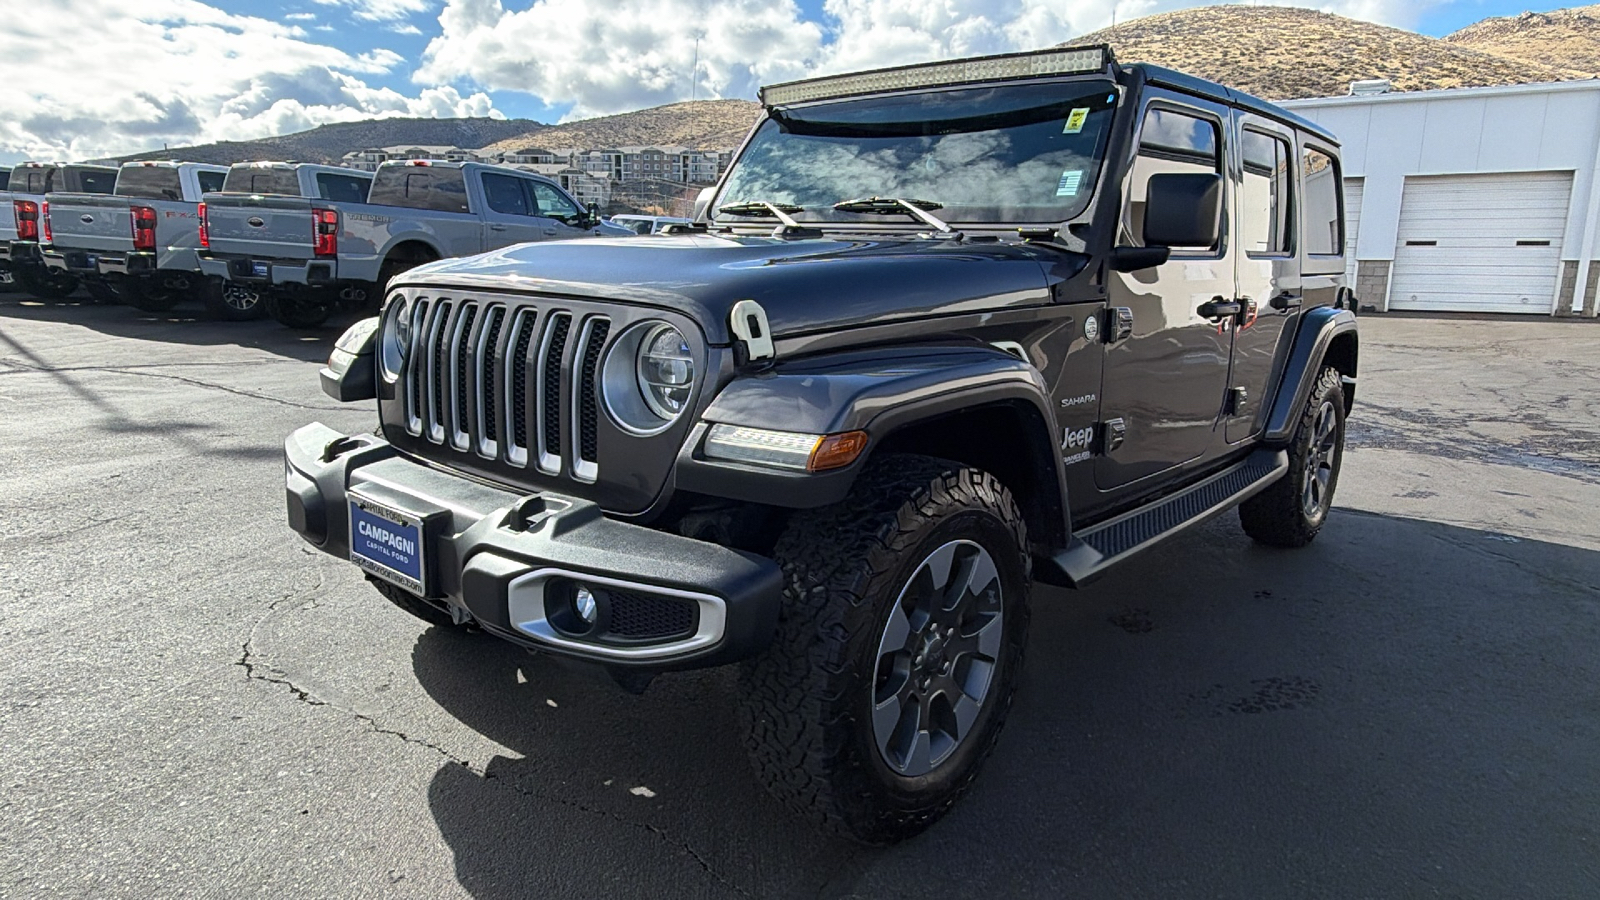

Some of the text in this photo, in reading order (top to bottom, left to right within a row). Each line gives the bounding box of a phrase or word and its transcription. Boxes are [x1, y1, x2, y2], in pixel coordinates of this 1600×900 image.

[1061, 394, 1096, 408] SAHARA
[1061, 426, 1094, 450] Jeep
[358, 520, 415, 556] CAMPAGNI
[366, 540, 409, 564] CAPITAL FORD
